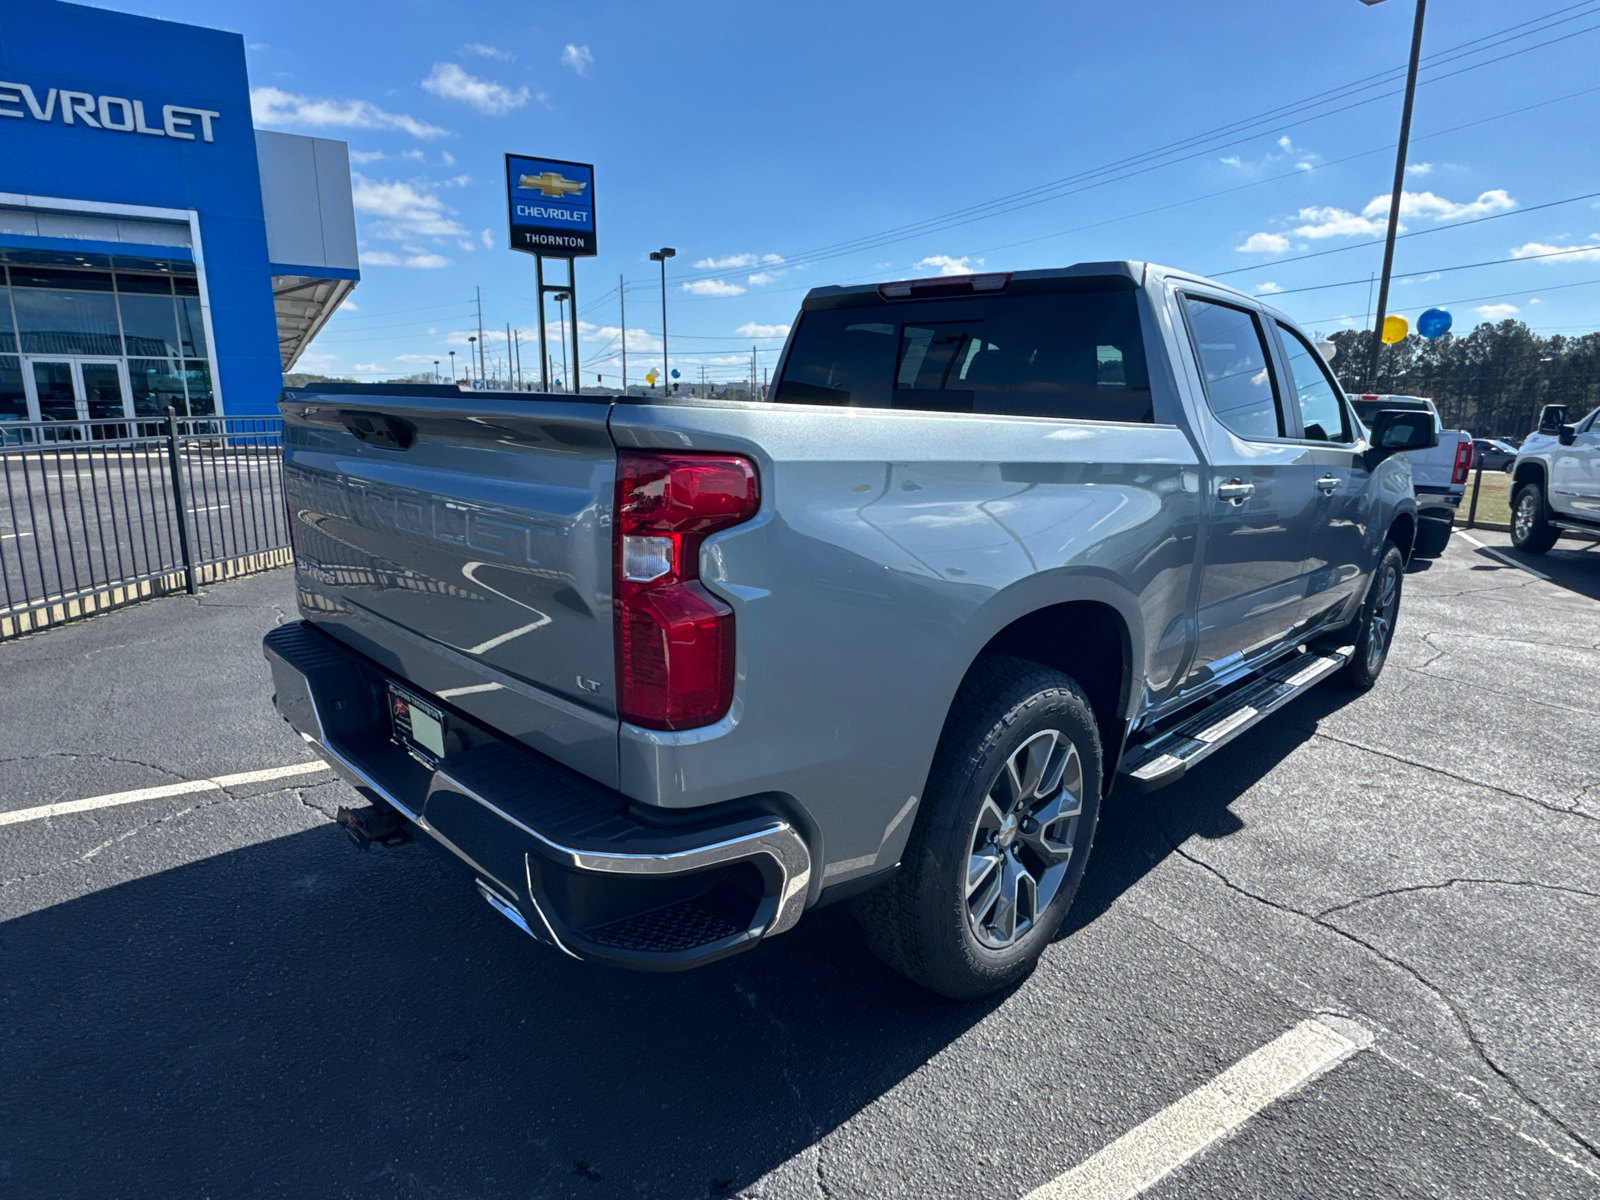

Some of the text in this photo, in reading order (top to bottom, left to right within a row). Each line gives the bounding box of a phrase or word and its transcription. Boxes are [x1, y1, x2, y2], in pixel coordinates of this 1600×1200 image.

[517, 205, 588, 222] CHEVROLET
[525, 233, 585, 247] THORNTON
[575, 675, 601, 692] LT
